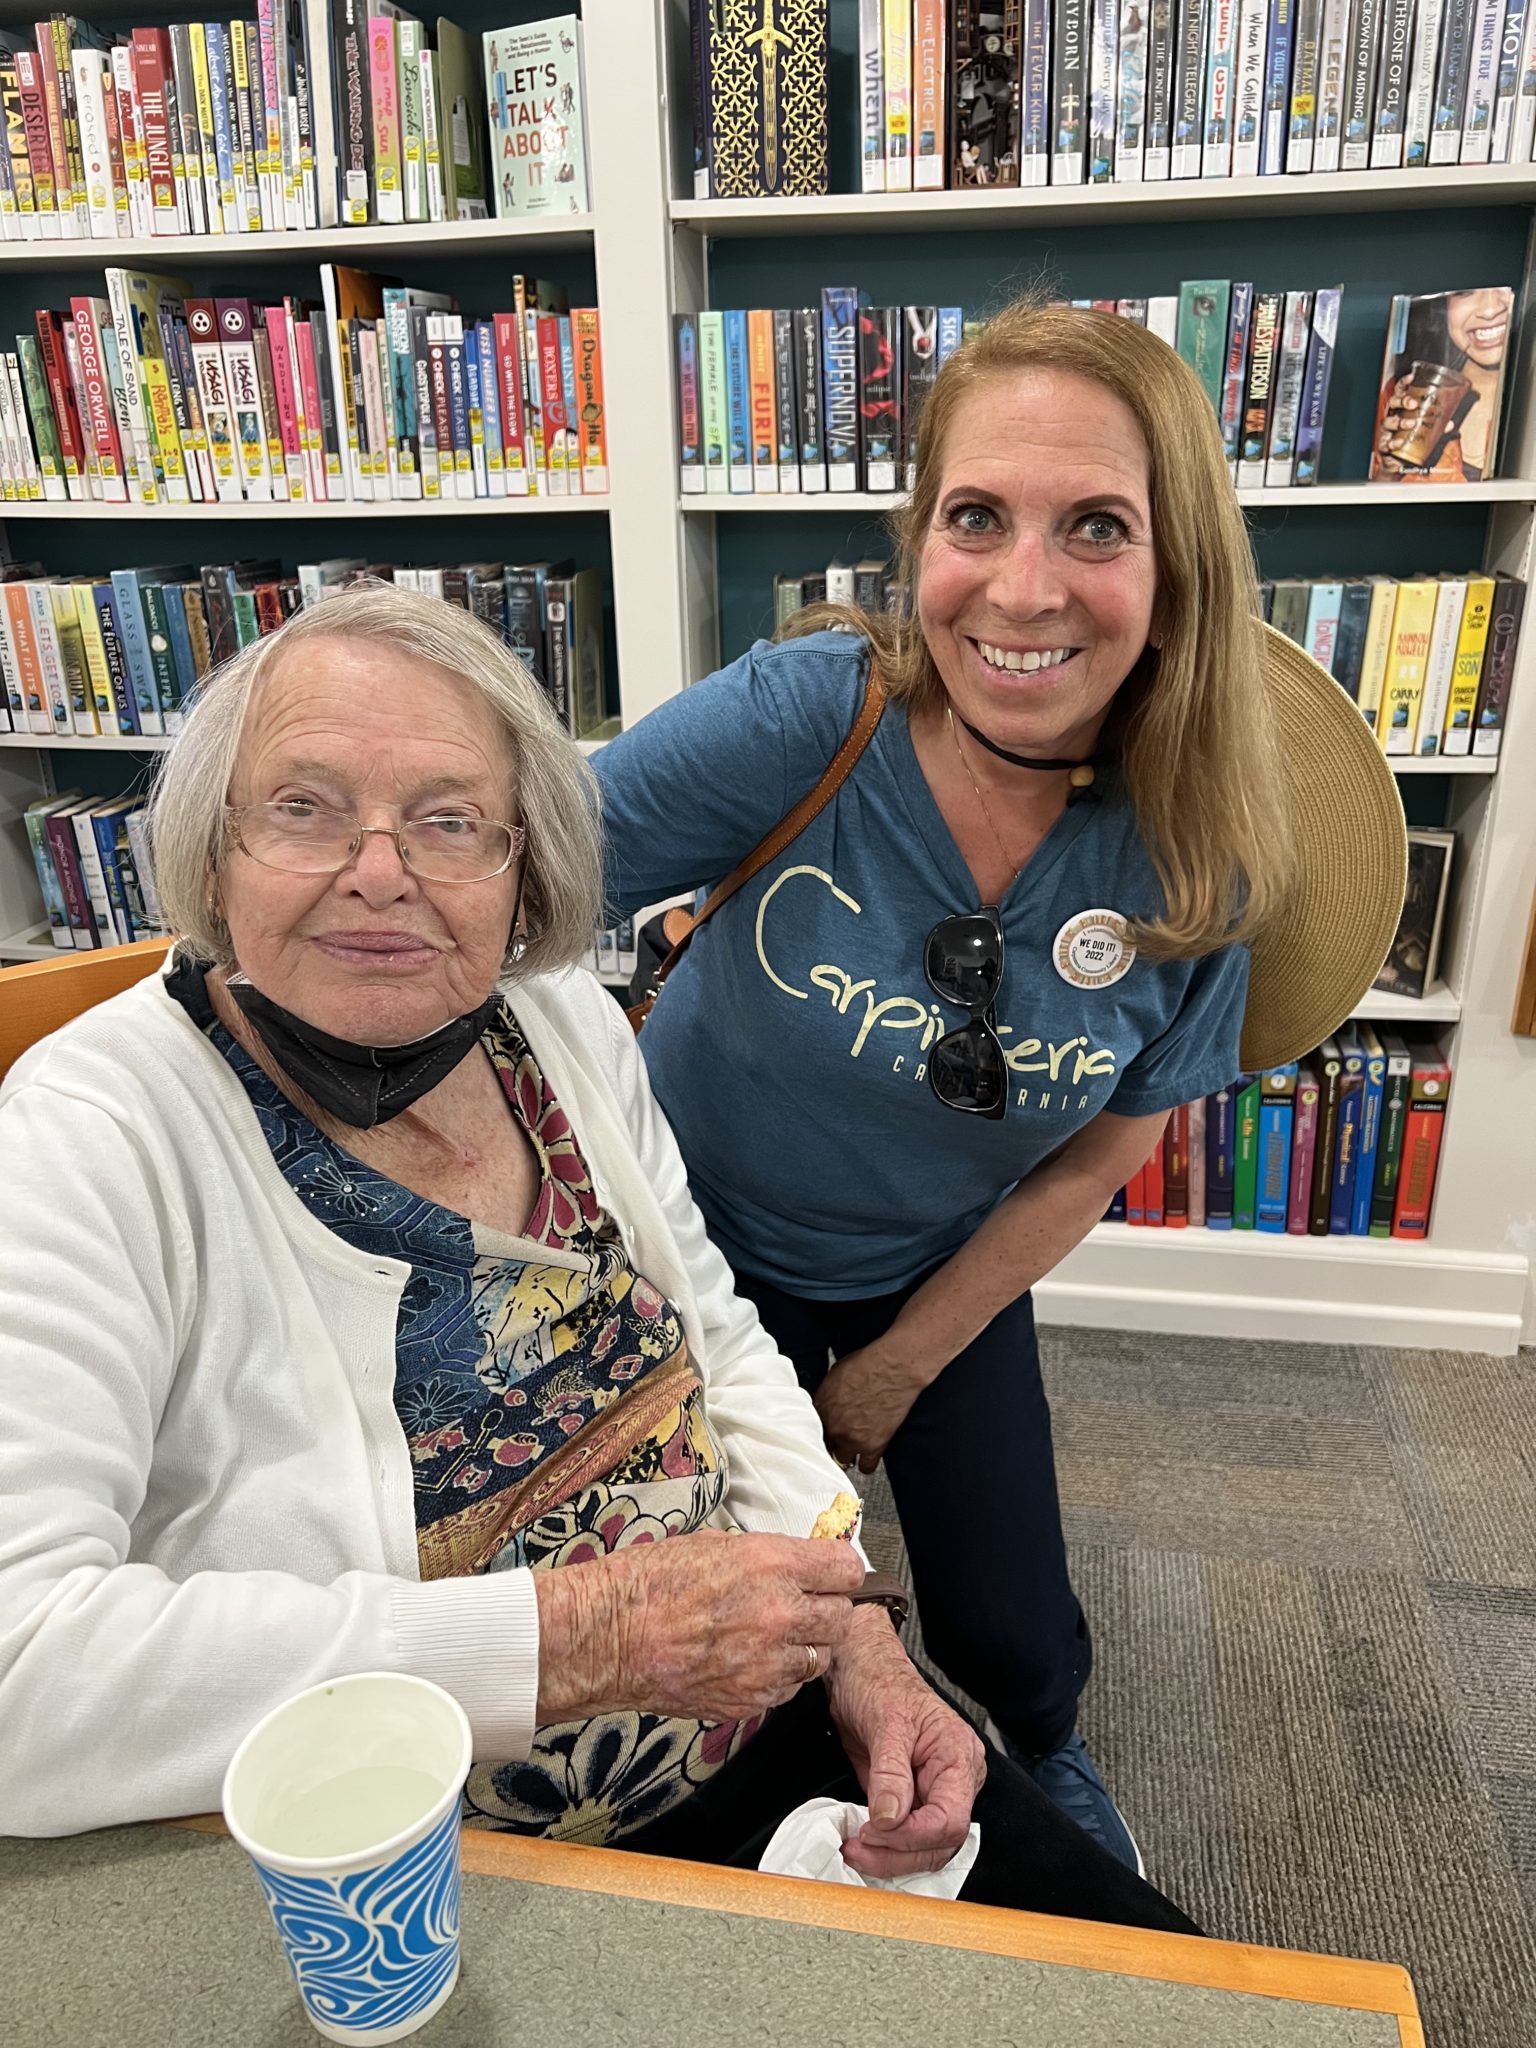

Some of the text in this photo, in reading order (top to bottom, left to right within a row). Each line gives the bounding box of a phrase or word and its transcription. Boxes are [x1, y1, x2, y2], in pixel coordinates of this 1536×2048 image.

[1249, 12, 1264, 50] When
[1477, 17, 1496, 81] THINGS TRUE
[922, 38, 935, 112] ELECTRIC
[1031, 45, 1045, 93] FEVER
[1183, 19, 1199, 121] NIGHT TELEGRAP
[1247, 54, 1261, 76] We
[1325, 39, 1342, 112] LEGEN
[1358, 51, 1368, 68] OF
[1389, 70, 1401, 86] OF
[507, 96, 557, 127] TALK
[1353, 72, 1367, 119] MIDNIG
[142, 90, 171, 178] THE JUNGLE
[351, 144, 364, 170] DE
[115, 314, 138, 405] TALE OF SAND
[479, 326, 491, 354] KISS
[1249, 303, 1276, 399] JAMES PATTERSON
[75, 309, 98, 376] GEORGE
[88, 381, 109, 441] ORWELL
[206, 360, 224, 404] USAGI
[237, 359, 254, 404] USAGI
[433, 362, 444, 394] CHECK
[451, 361, 463, 394] CHECK
[483, 359, 494, 413] NUMBER
[544, 346, 558, 400] BOXERS
[563, 346, 575, 398] SAINTS
[580, 339, 597, 403] Dragon
[754, 383, 771, 441] FURI
[101, 607, 112, 628] THE
[16, 618, 29, 654] WHAT
[24, 658, 33, 669] IF
[118, 588, 148, 696] GLASS SWO
[112, 677, 125, 692] OF
[1456, 660, 1480, 676] SON
[51, 684, 62, 706] LOS
[117, 695, 127, 710] US
[1079, 938, 1116, 953] WE DID IT!
[1085, 950, 1104, 961] 2022
[893, 1056, 1088, 1111] CARNIA
